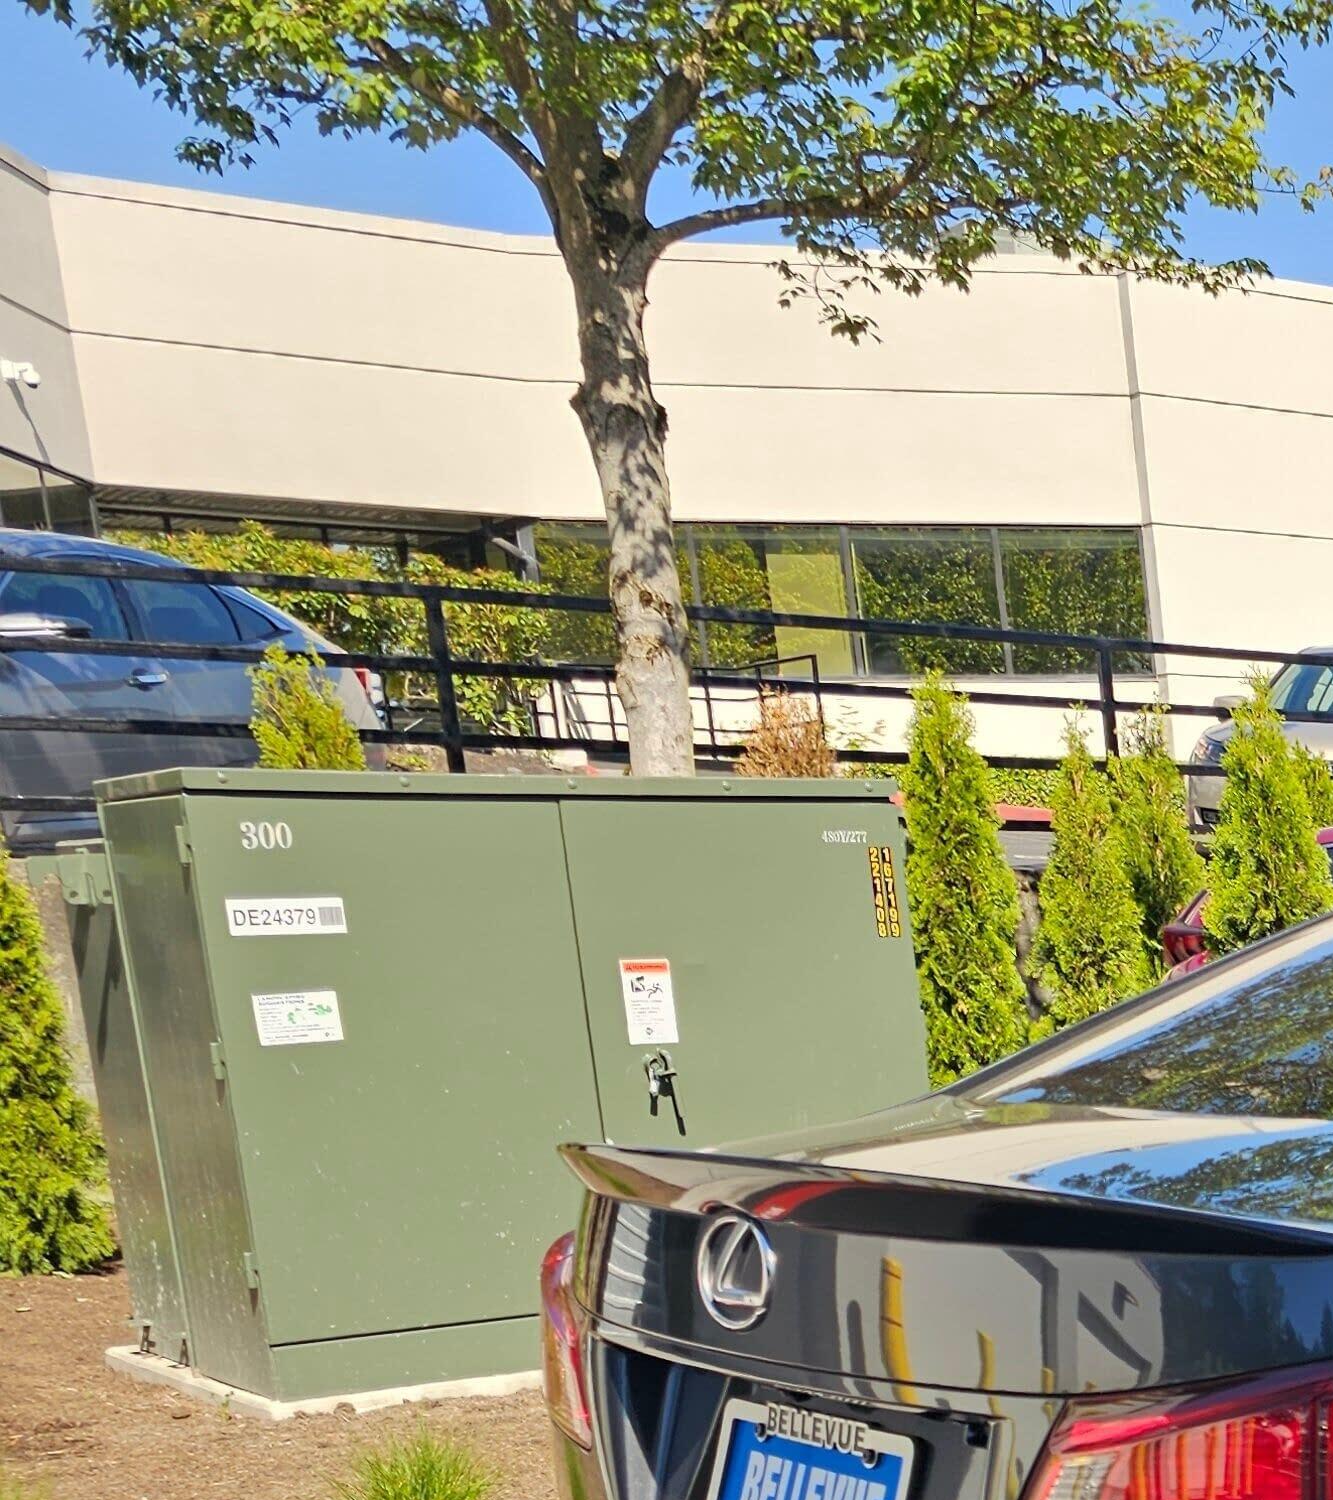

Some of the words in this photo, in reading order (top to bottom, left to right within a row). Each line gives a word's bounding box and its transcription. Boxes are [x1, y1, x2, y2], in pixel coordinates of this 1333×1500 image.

[240, 821, 293, 850] 300
[232, 908, 317, 927] DE24379
[767, 1406, 867, 1452] BELLEVUE
